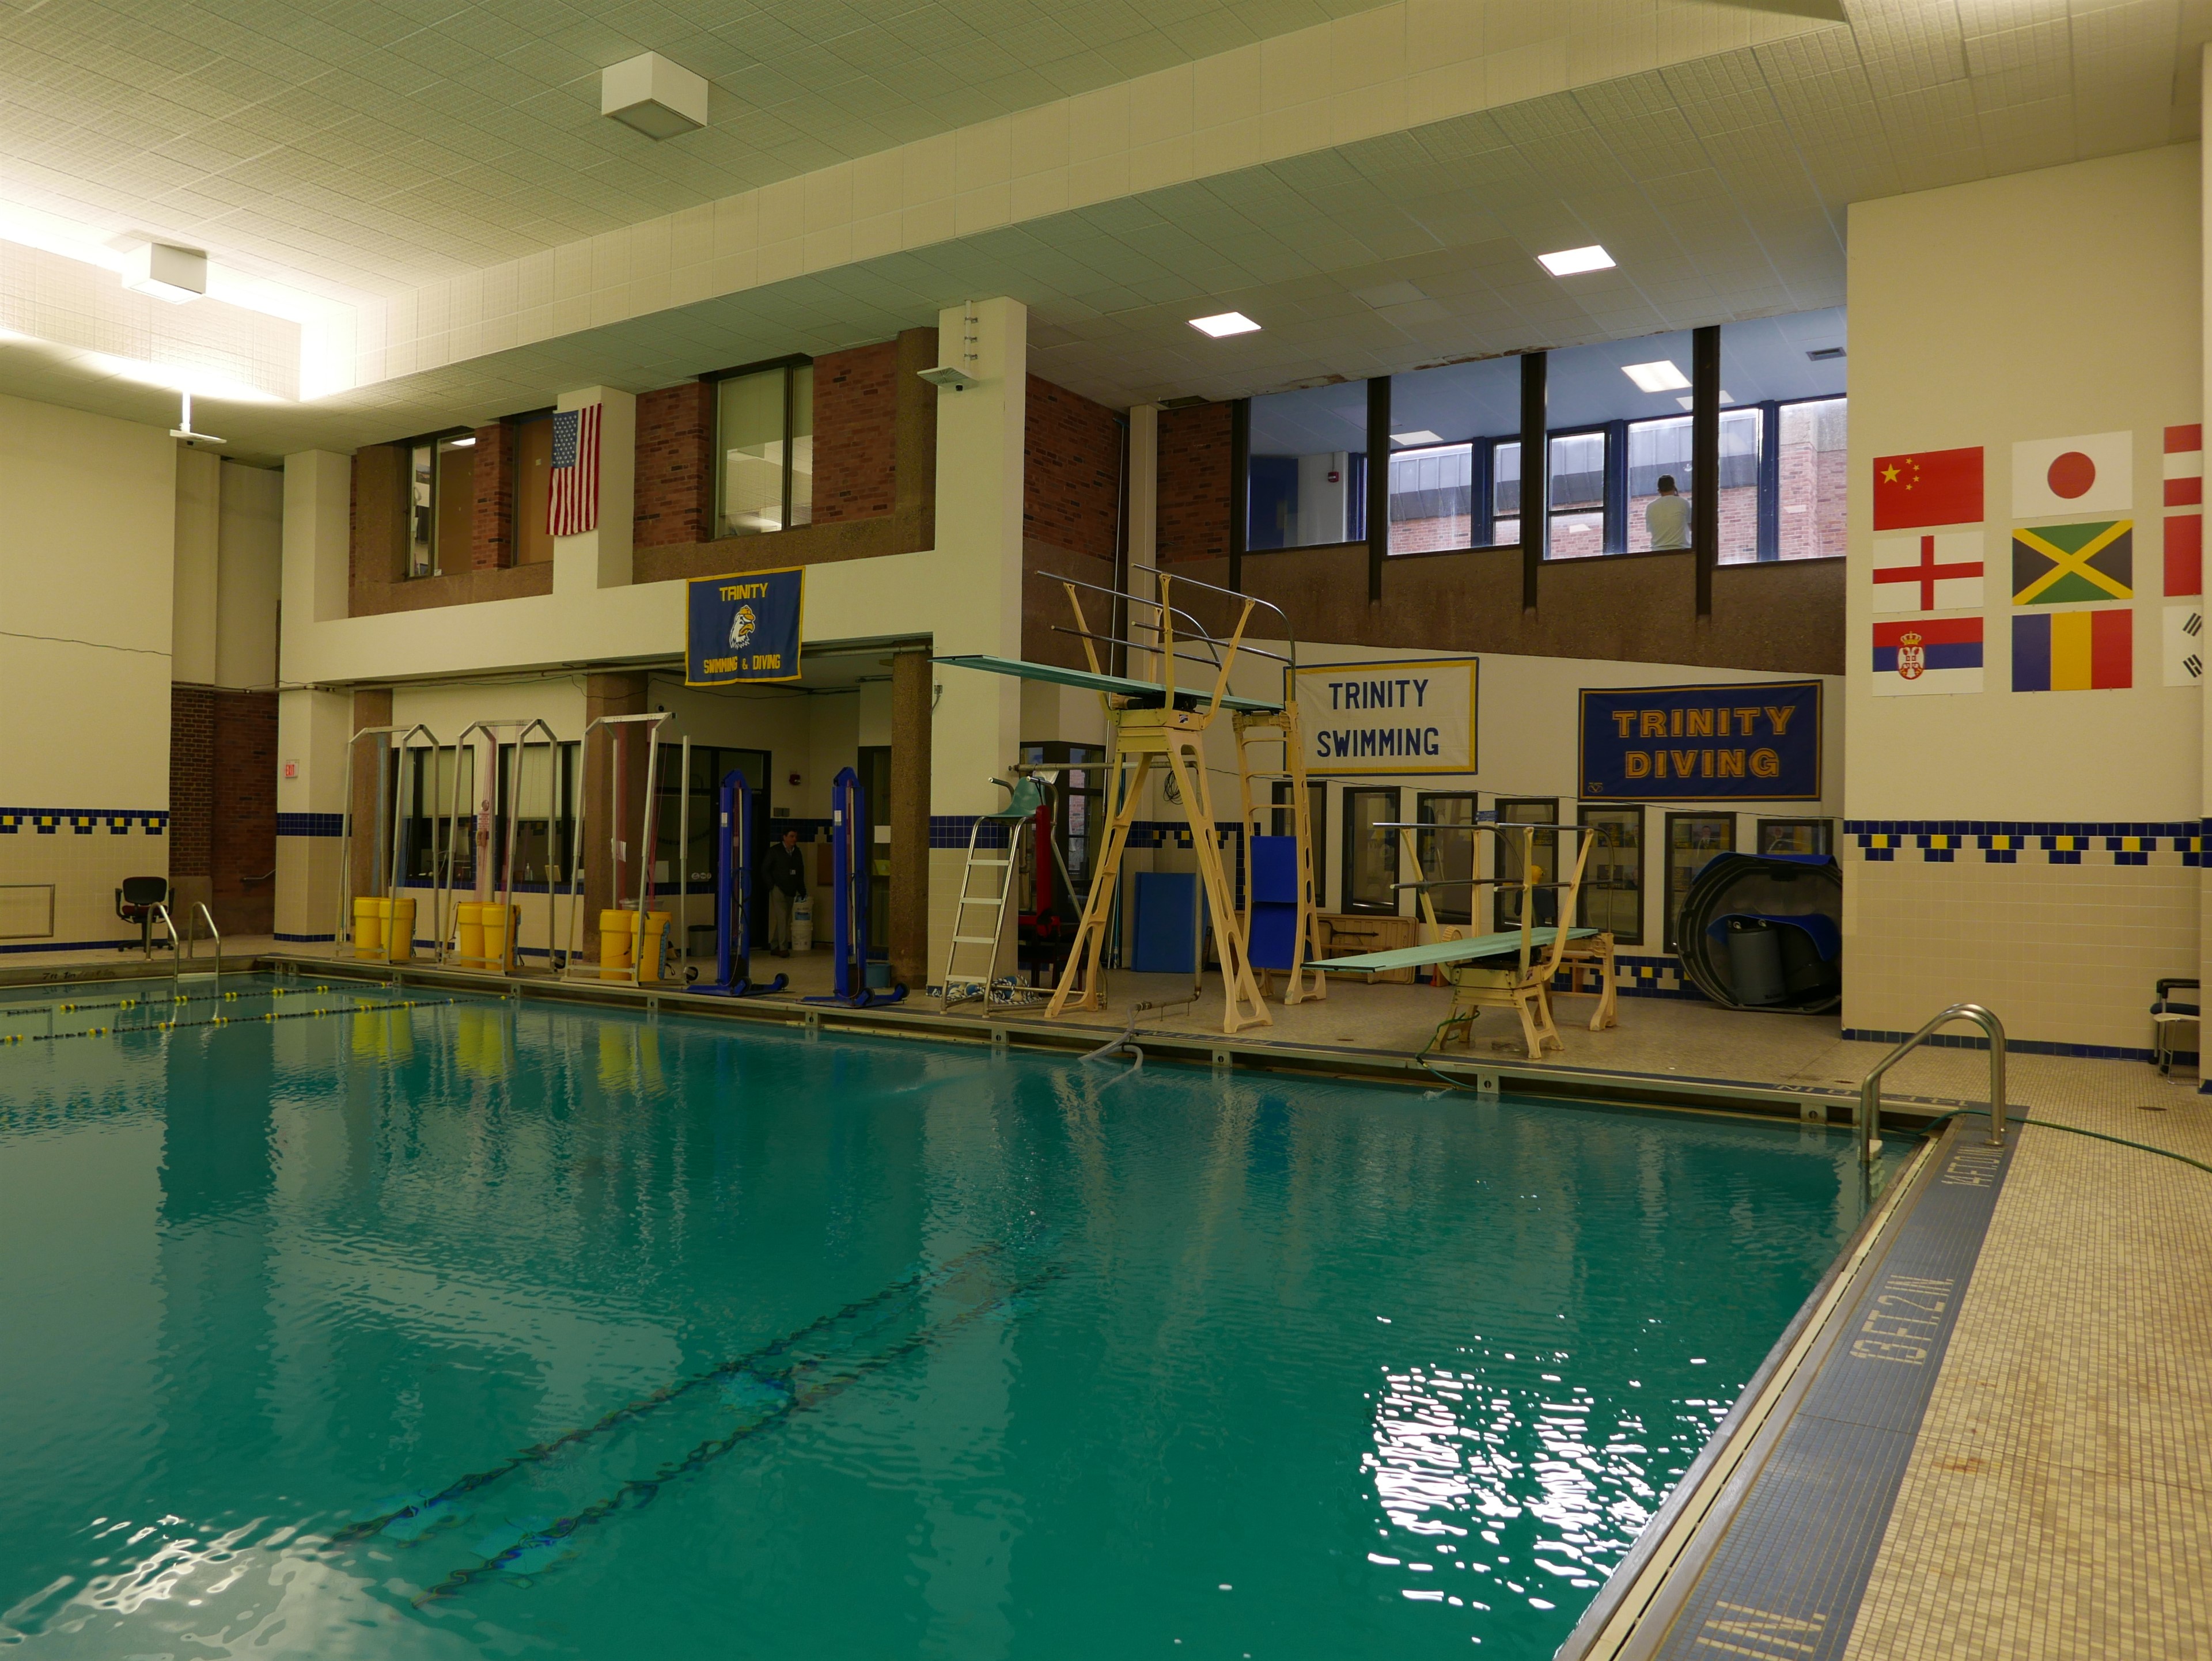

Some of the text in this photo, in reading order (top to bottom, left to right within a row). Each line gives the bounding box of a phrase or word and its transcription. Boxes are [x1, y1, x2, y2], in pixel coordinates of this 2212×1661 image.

[719, 582, 768, 601] TRINITY
[704, 654, 781, 674] SWIMMING & DIVING
[1328, 679, 1429, 710] TRINITY
[1612, 706, 1796, 738] TRINITY
[1317, 727, 1439, 757] SWIMMING
[1625, 748, 1779, 778] DIVING
[1850, 1275, 1955, 1364] 13 FT. 2 IN.
